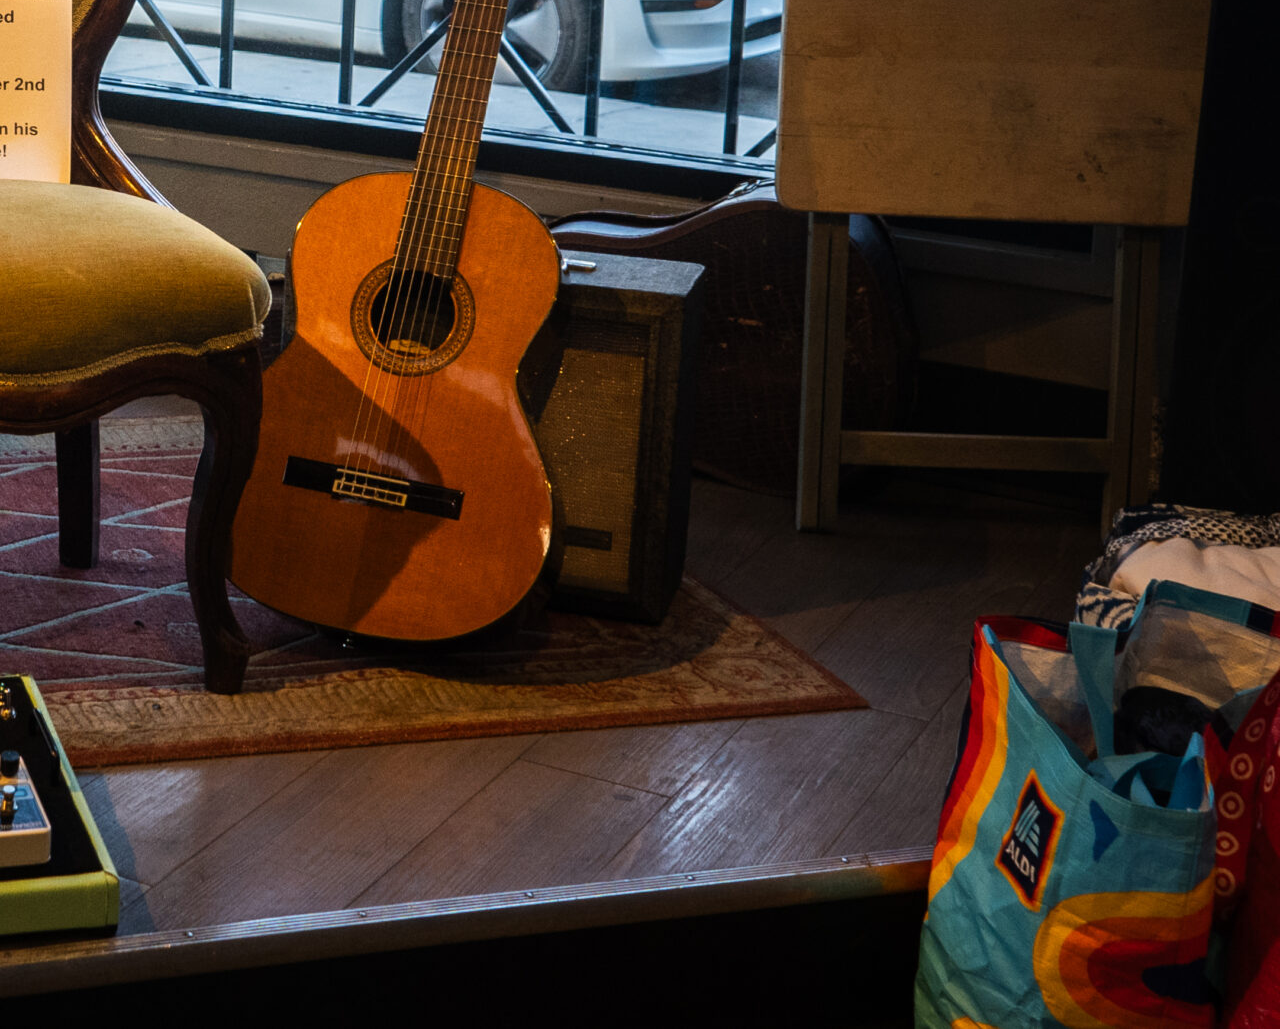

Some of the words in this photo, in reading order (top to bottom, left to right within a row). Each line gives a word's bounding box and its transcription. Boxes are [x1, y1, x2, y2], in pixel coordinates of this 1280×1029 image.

[14, 77, 45, 91] 2nd
[14, 122, 39, 136] his
[1005, 839, 1036, 884] ALDI
